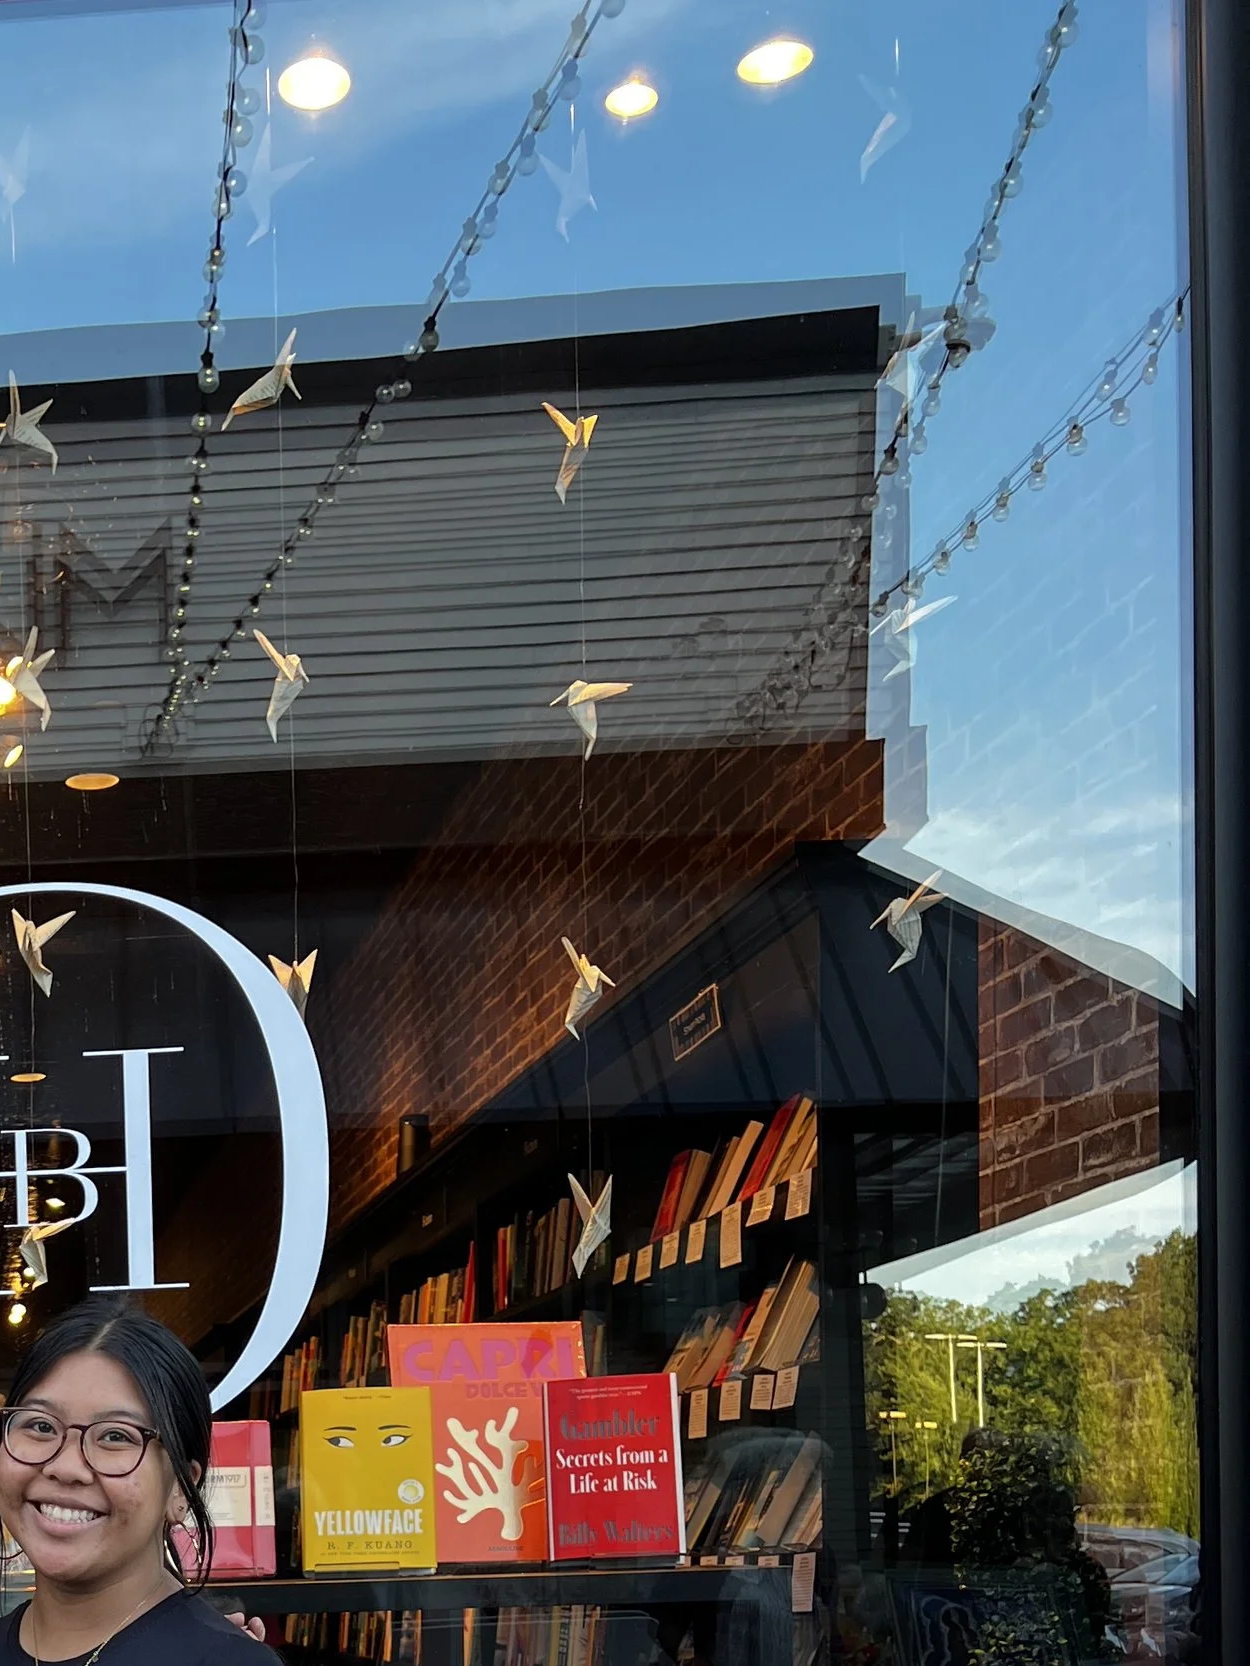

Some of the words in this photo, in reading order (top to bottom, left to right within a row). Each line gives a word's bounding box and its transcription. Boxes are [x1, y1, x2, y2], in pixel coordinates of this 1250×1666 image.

[401, 1335, 574, 1382] CAPRI
[559, 1408, 660, 1441] Gambler
[555, 1447, 613, 1469] Secrets
[616, 1444, 655, 1466] from
[658, 1448, 669, 1464] a
[569, 1471, 599, 1494] Life
[602, 1472, 620, 1492] at
[622, 1468, 658, 1492] Risk
[314, 1508, 424, 1537] YELLOWFACE
[558, 1521, 597, 1548] Billy
[602, 1519, 674, 1545] Walters
[327, 1540, 342, 1551] R.
[365, 1540, 413, 1550] KUANG
